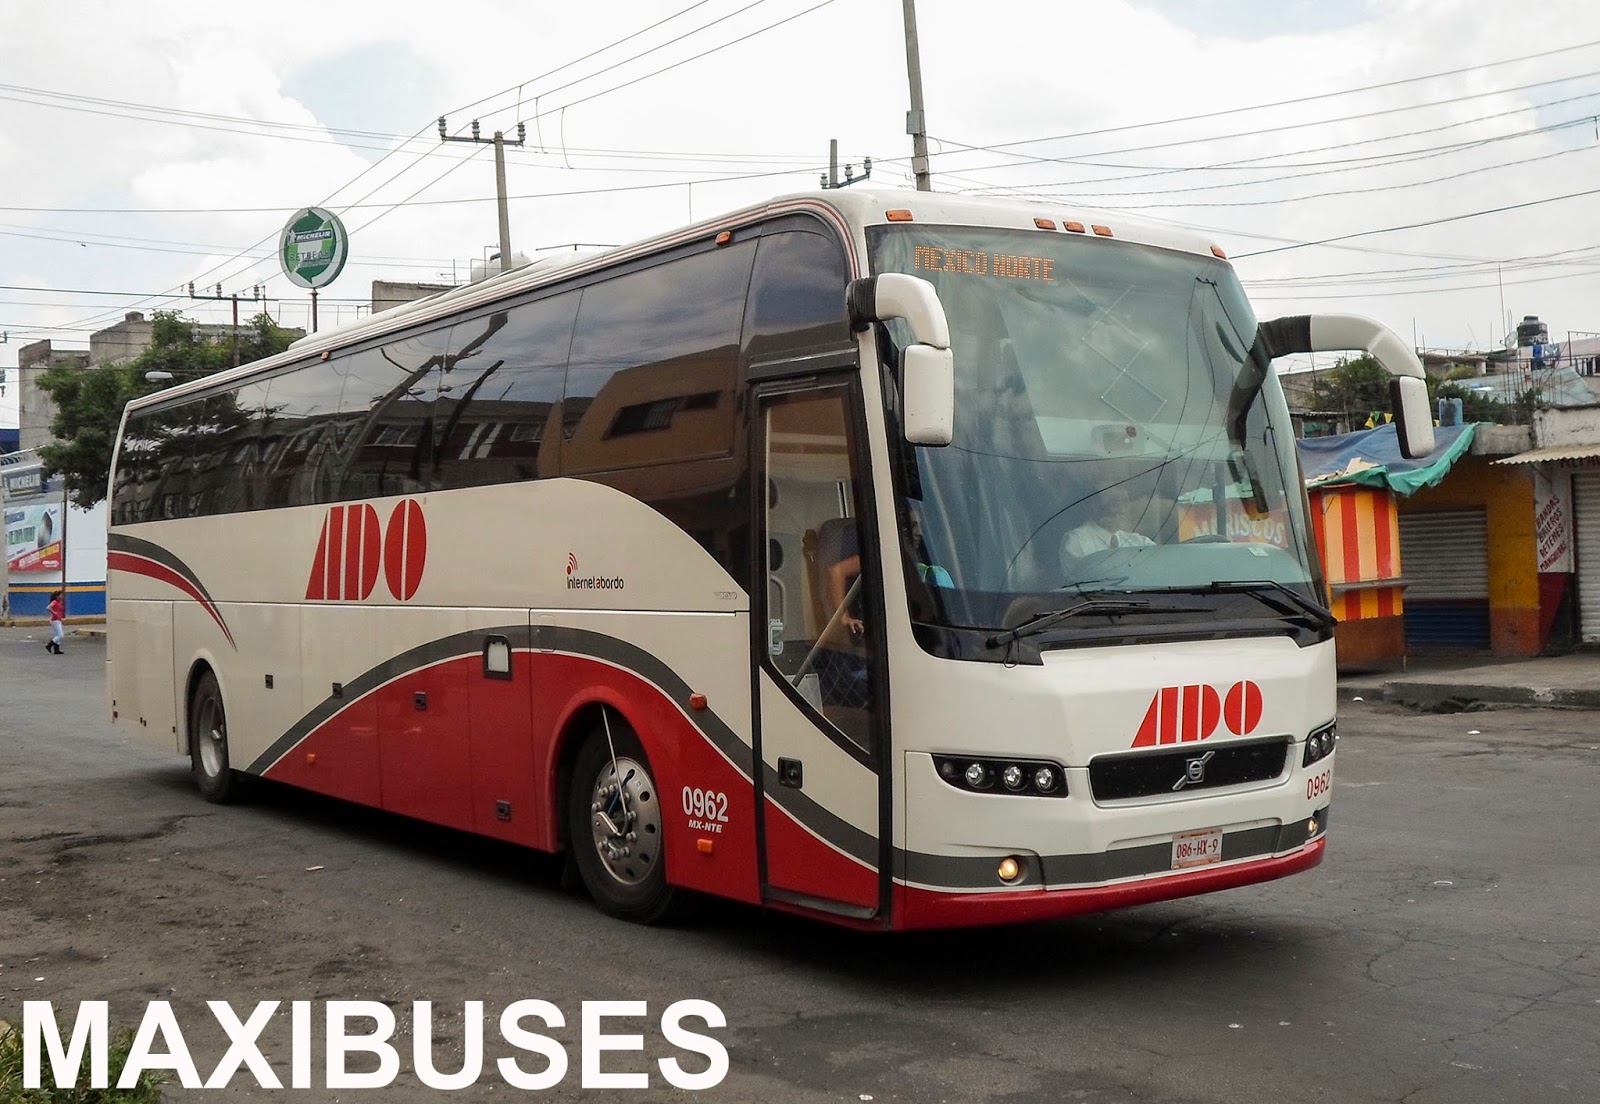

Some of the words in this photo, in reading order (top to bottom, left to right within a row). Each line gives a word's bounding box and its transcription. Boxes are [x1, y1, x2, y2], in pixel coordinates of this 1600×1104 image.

[296, 231, 331, 241] MICHELIN
[915, 245, 988, 275] MEXICO
[993, 253, 1056, 281] NORTE
[1535, 493, 1561, 529] BANDAS
[305, 498, 428, 601] ADO
[1130, 679, 1264, 749] ADO
[1306, 769, 1331, 800] 0962
[682, 785, 729, 823] 0962
[688, 819, 723, 834] MX-NTE
[1176, 838, 1219, 859] 086-HX-9
